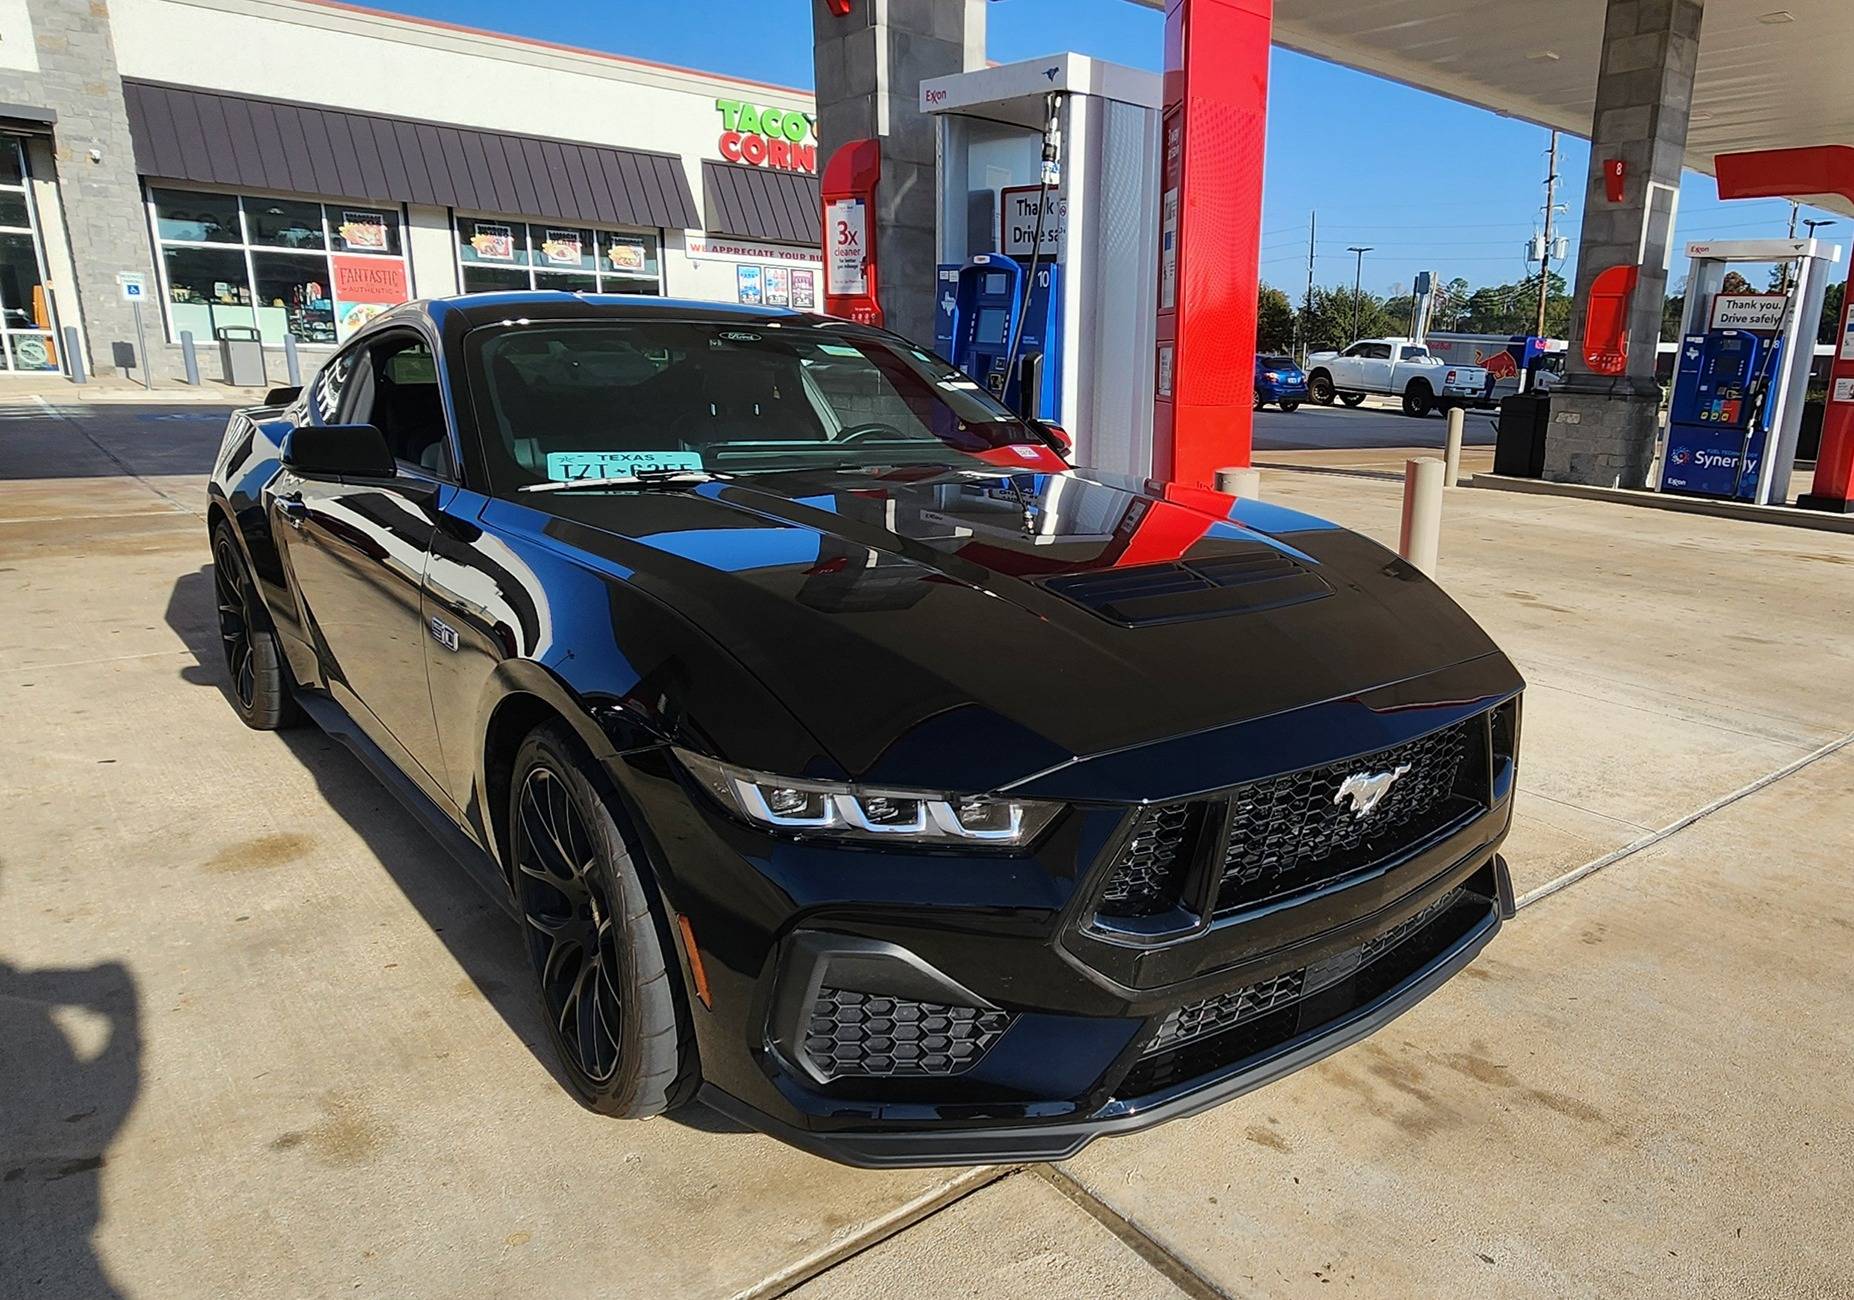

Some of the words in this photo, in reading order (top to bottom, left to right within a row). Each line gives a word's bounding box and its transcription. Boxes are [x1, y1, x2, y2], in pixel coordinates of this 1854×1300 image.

[926, 90, 947, 104] Exxon
[716, 99, 808, 142] TACO
[719, 131, 816, 172] CORN
[1616, 162, 1622, 175] 8
[837, 220, 858, 245] 3x
[712, 245, 774, 257] APPRECIATE
[778, 251, 806, 260] YOUR
[834, 247, 861, 257] cleaner
[340, 267, 398, 287] FANTASTIC
[1037, 271, 1049, 288] 10
[348, 286, 393, 295] AUTHENTIC
[1726, 299, 1757, 310] Thank
[1759, 301, 1781, 312] you.
[1720, 313, 1748, 324] Drive
[1668, 477, 1686, 487] Exxon
